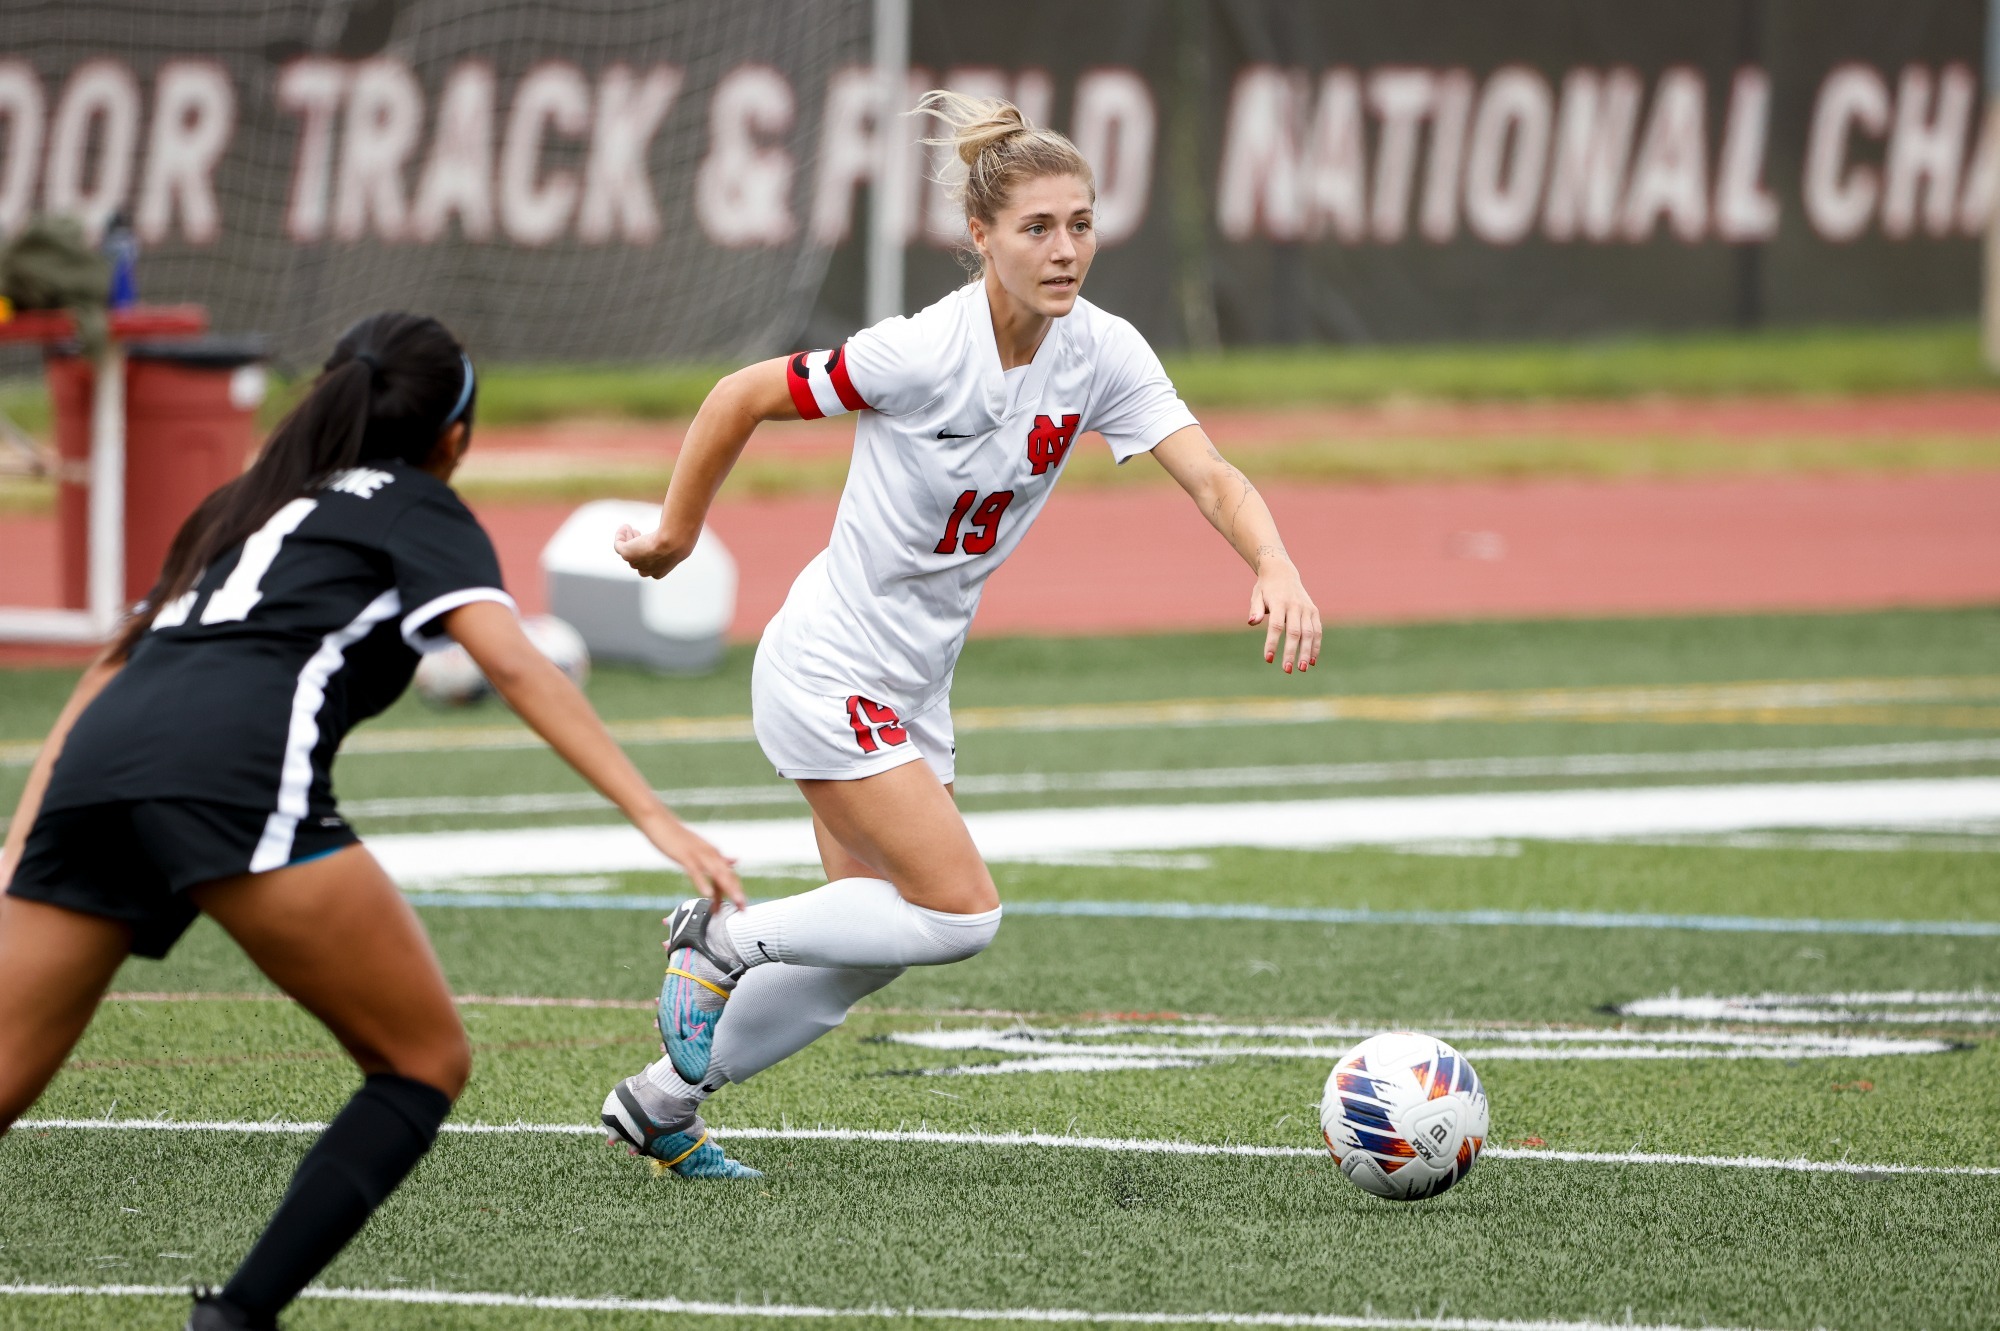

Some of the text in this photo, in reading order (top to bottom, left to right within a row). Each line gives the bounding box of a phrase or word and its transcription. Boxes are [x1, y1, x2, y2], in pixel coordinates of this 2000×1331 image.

[275, 56, 686, 246] TRACK
[695, 62, 803, 247] &
[1213, 62, 1783, 246] NATIONAL
[933, 489, 1014, 555] 19
[1411, 1137, 1435, 1161] NCAA
